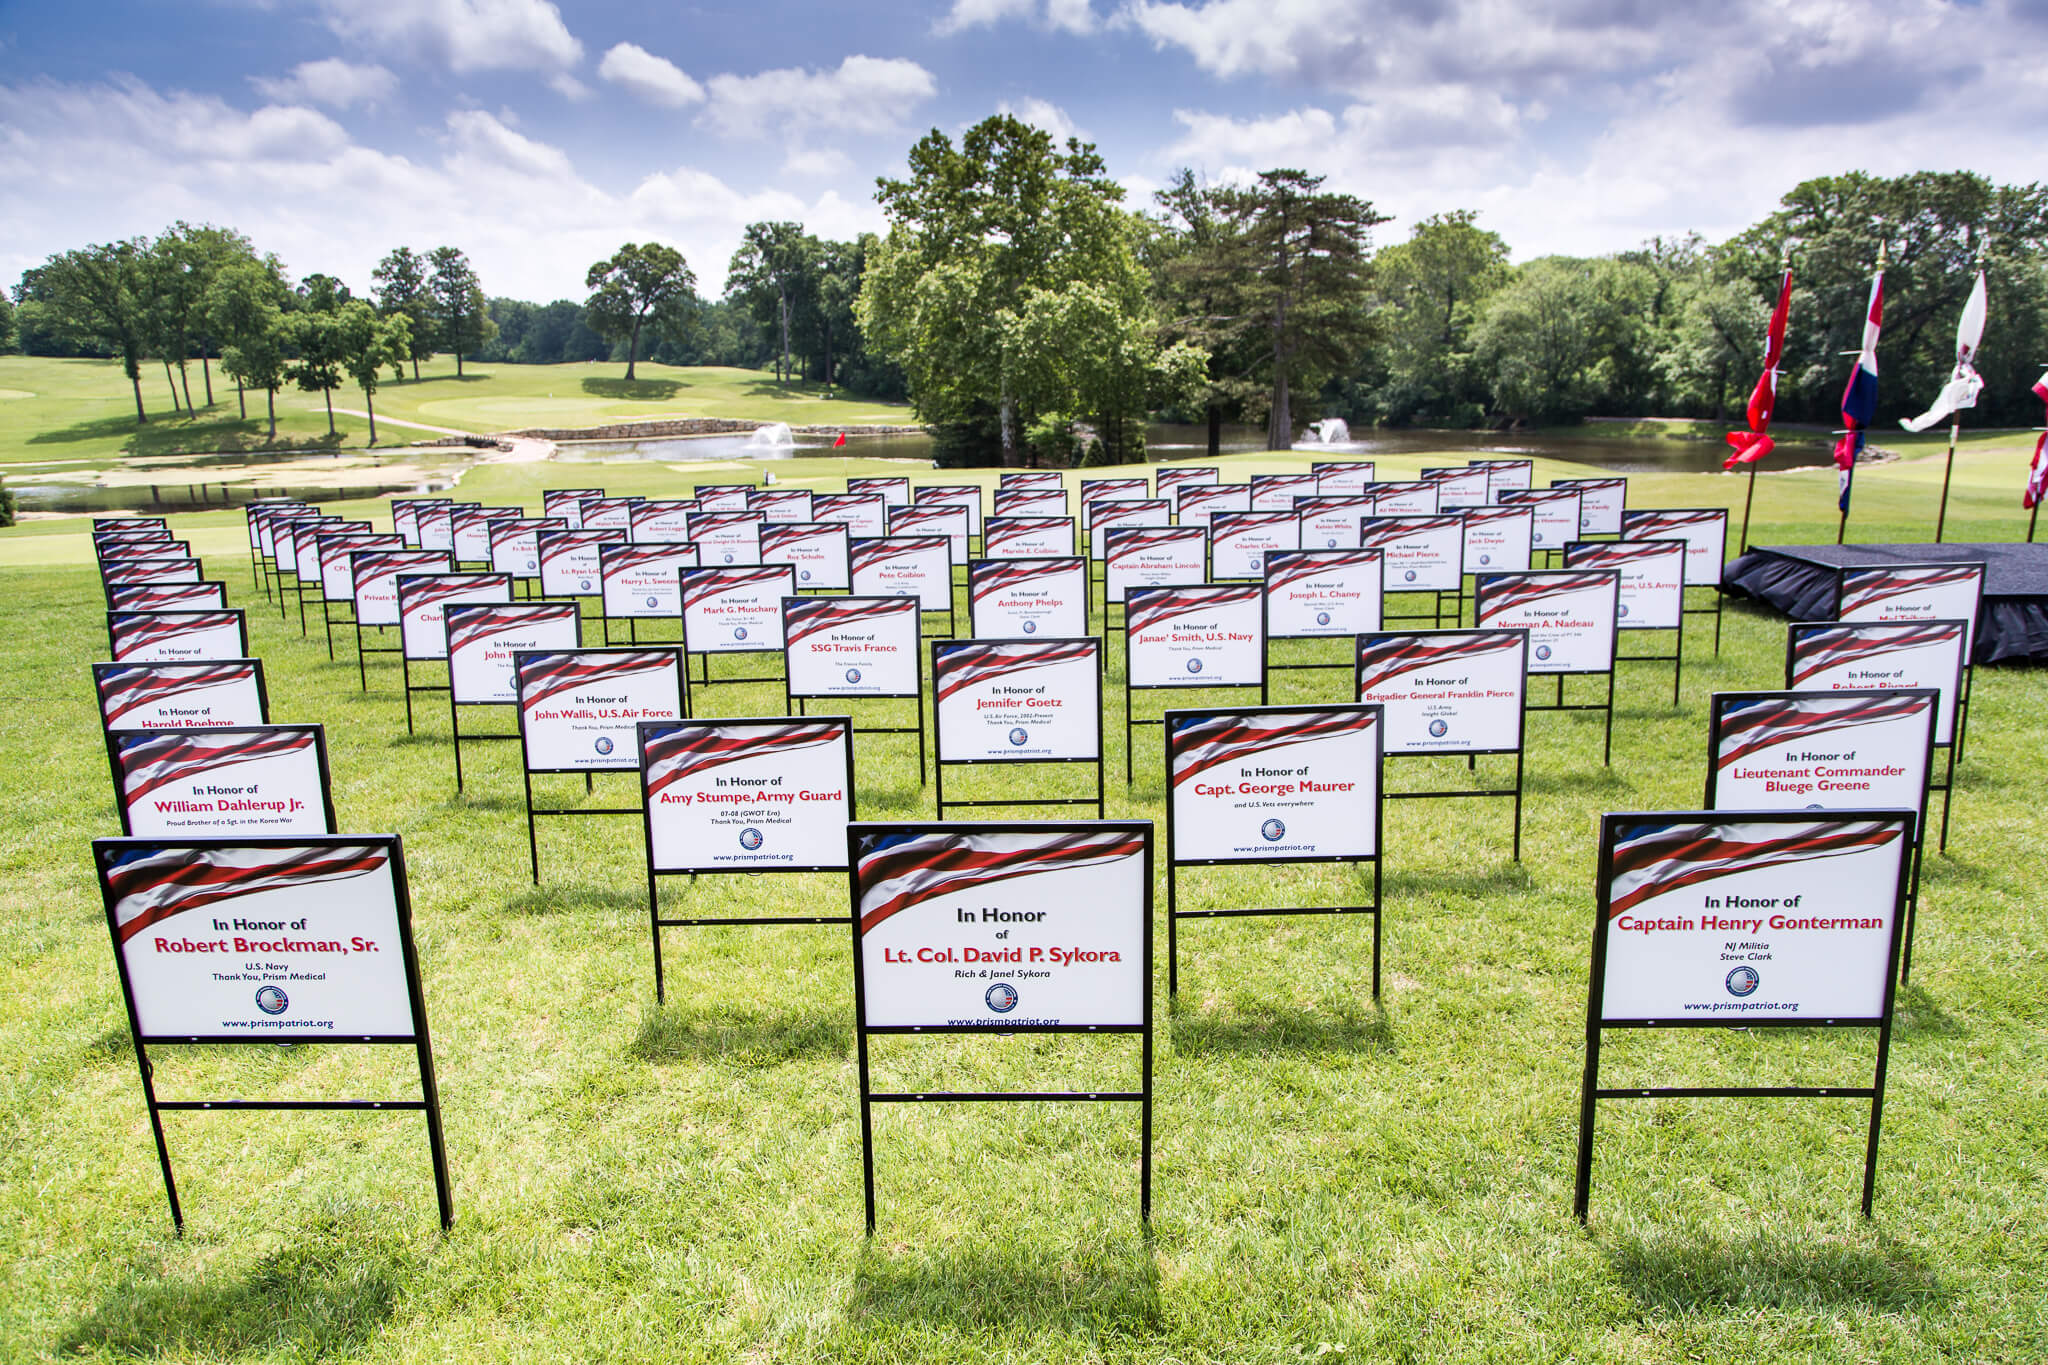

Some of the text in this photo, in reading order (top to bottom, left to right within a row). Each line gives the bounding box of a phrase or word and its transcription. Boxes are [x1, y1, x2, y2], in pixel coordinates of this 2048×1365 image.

[1290, 592, 1317, 600] Joseph
[1329, 591, 1360, 599] Chaney
[998, 599, 1063, 608] Anthony Phelps
[738, 606, 778, 614] Muschany
[1138, 633, 1253, 644] Janae' Smith, U.S. Navy
[811, 644, 897, 652] SSG Travis France
[485, 651, 510, 660] John
[1893, 670, 1904, 678] of
[1415, 677, 1469, 686] In Honor of
[576, 696, 584, 704] In
[1367, 693, 1408, 702] Brigadier
[1410, 691, 1445, 699] General
[1448, 690, 1484, 698] Franklin
[977, 698, 1062, 710] Jennifer Goetz
[169, 708, 199, 716] Honor
[201, 707, 210, 715] of
[535, 709, 672, 721] John Wallis, U.S. Air Force
[1786, 751, 1856, 761] In Honor of
[1241, 766, 1309, 777] In Honor of
[1734, 767, 1905, 779] Lieutenant Commander
[716, 777, 782, 786] In Honor of
[193, 785, 258, 795] In Honor of
[1195, 781, 1355, 798] Capt. George Maurer
[1766, 780, 1870, 794] Bluege Greene
[661, 790, 841, 806] Amy Stumpe, Army Guard
[154, 798, 304, 813] William Dahlerup Jr.
[1277, 800, 1314, 808] everywhere
[1234, 845, 1315, 853] www.prismpatriot.org
[714, 854, 793, 862] www.prismpatriot.org
[1705, 895, 1802, 908] In Honor of
[958, 908, 1046, 922] In Honor
[213, 918, 307, 930] In Honor of
[1618, 915, 1883, 935] Captain Henry Gonterman
[996, 930, 1009, 939] of
[155, 937, 379, 955] Robert Brockman, Sr.
[1724, 942, 1769, 951] NJ Militia
[885, 947, 1121, 967] Lt. Col. David P. Sykora
[266, 963, 288, 972] Navy
[242, 973, 261, 981] You,
[955, 970, 975, 978] Rich
[989, 970, 1014, 980] Janel
[1017, 970, 1050, 980] Sykora
[1684, 1001, 1799, 1012] www.prismpatriot.org
[222, 1019, 333, 1029] www.prismpatriot.org
